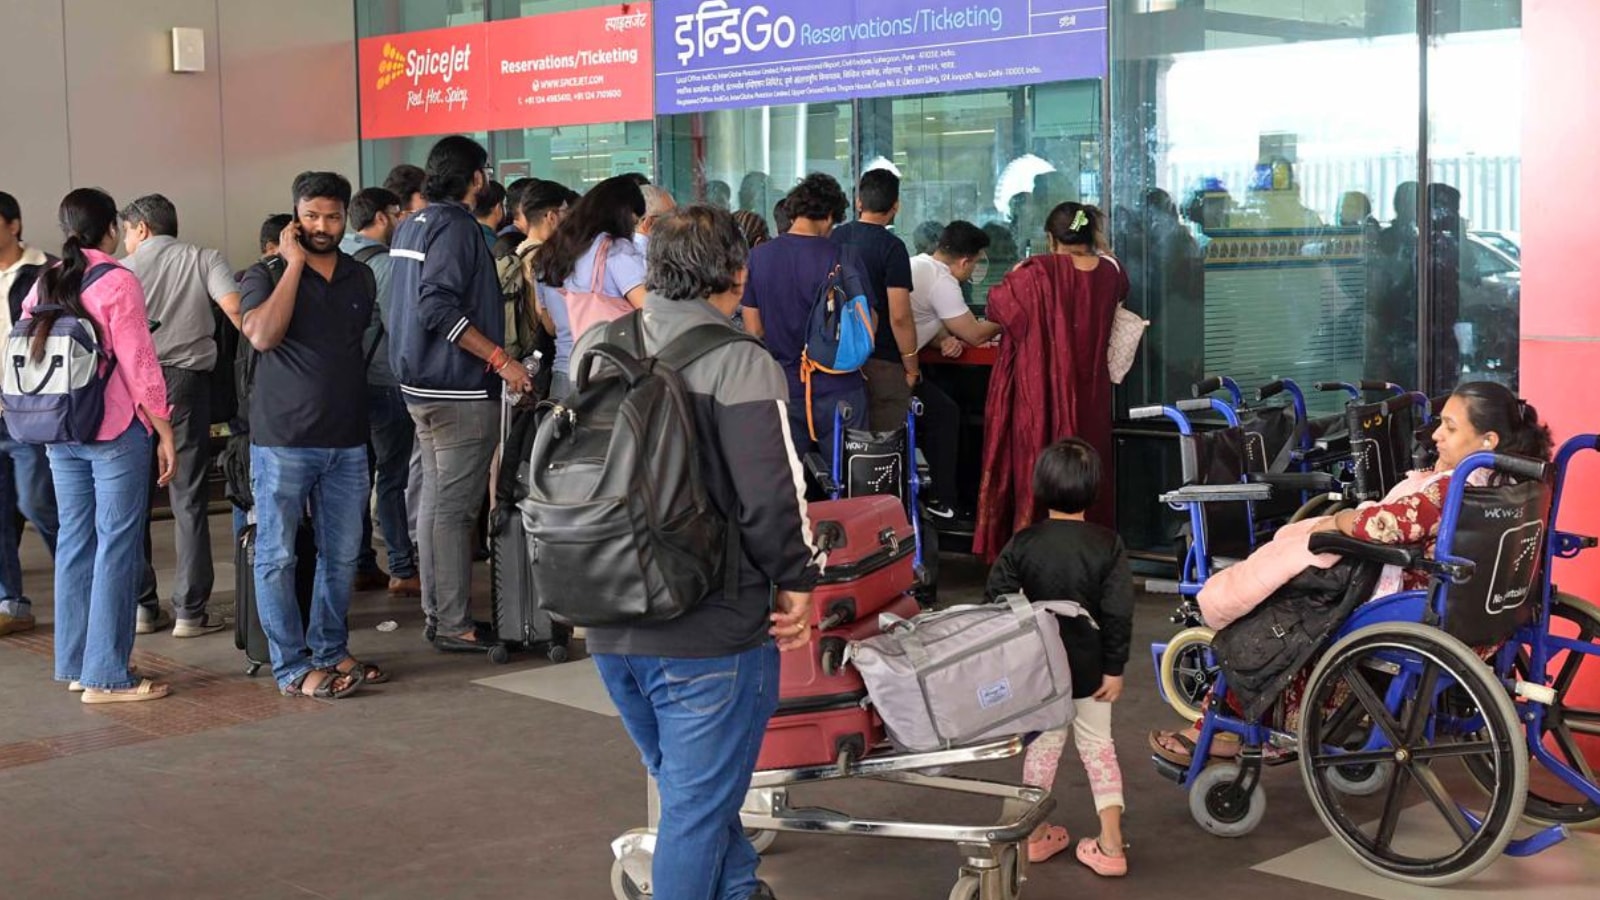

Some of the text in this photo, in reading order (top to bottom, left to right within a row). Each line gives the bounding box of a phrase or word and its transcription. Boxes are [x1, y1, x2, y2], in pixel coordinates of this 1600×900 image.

[801, 5, 1003, 46] Reservations/Ticketing
[405, 43, 471, 86] SpiceJet
[501, 47, 638, 74] Reservations/Ticketing
[541, 75, 604, 88] WWW.SPICEJET.COM
[406, 88, 424, 111] Red.
[425, 87, 444, 113] Hot.
